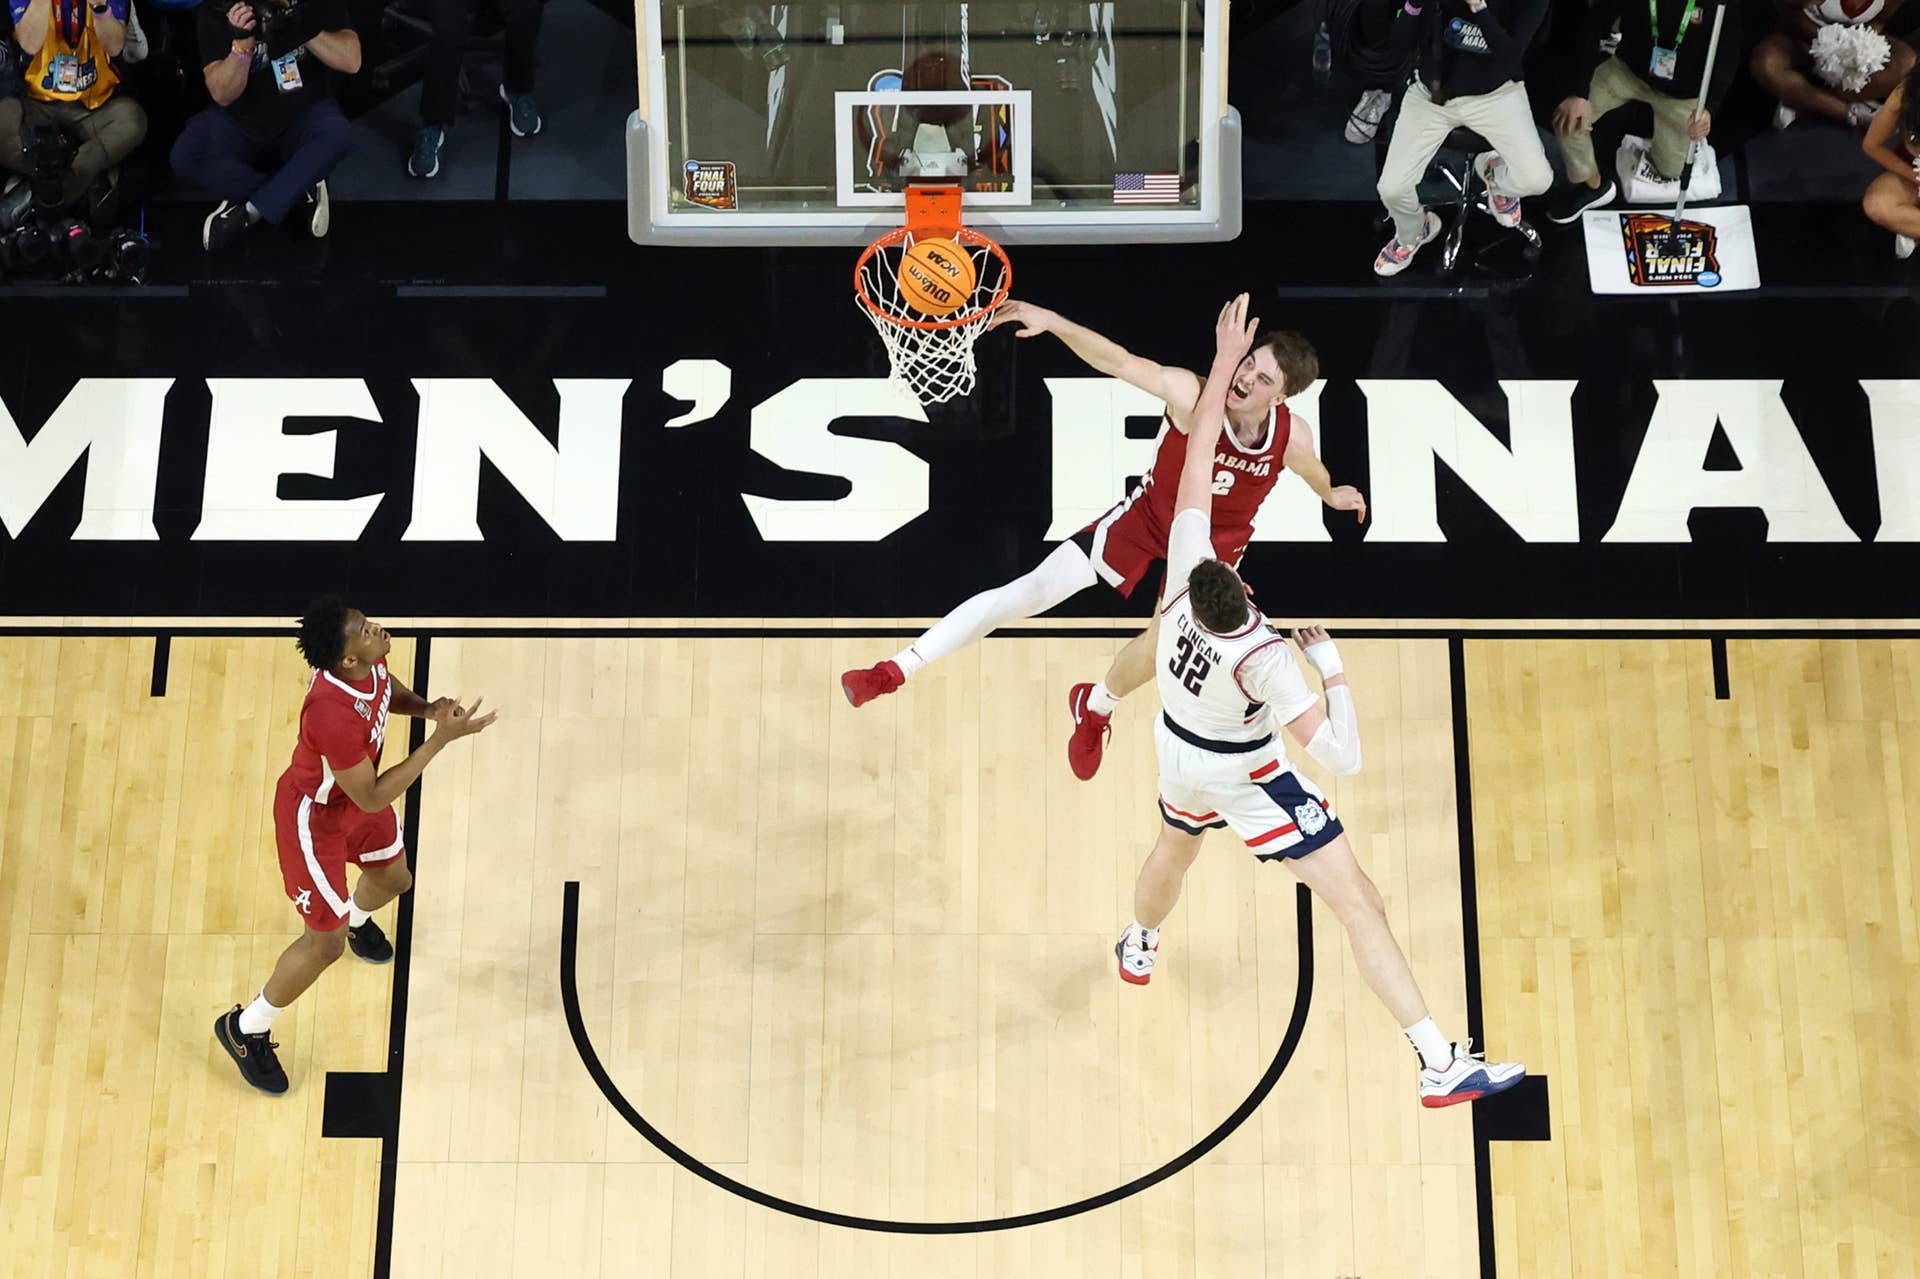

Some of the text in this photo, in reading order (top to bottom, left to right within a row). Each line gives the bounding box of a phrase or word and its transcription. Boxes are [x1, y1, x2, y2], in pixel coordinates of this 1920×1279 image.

[692, 170, 725, 181] FINAL
[693, 181, 725, 192] FOUR
[1645, 241, 1704, 259] FR
[926, 250, 960, 278] NCAA
[1645, 256, 1706, 274] FINAL
[908, 265, 951, 304] Wilson
[1214, 452, 1271, 477] ABAMA
[1211, 470, 1236, 496] 2
[1177, 613, 1222, 665] CLINGAN
[1169, 635, 1211, 697] 32
